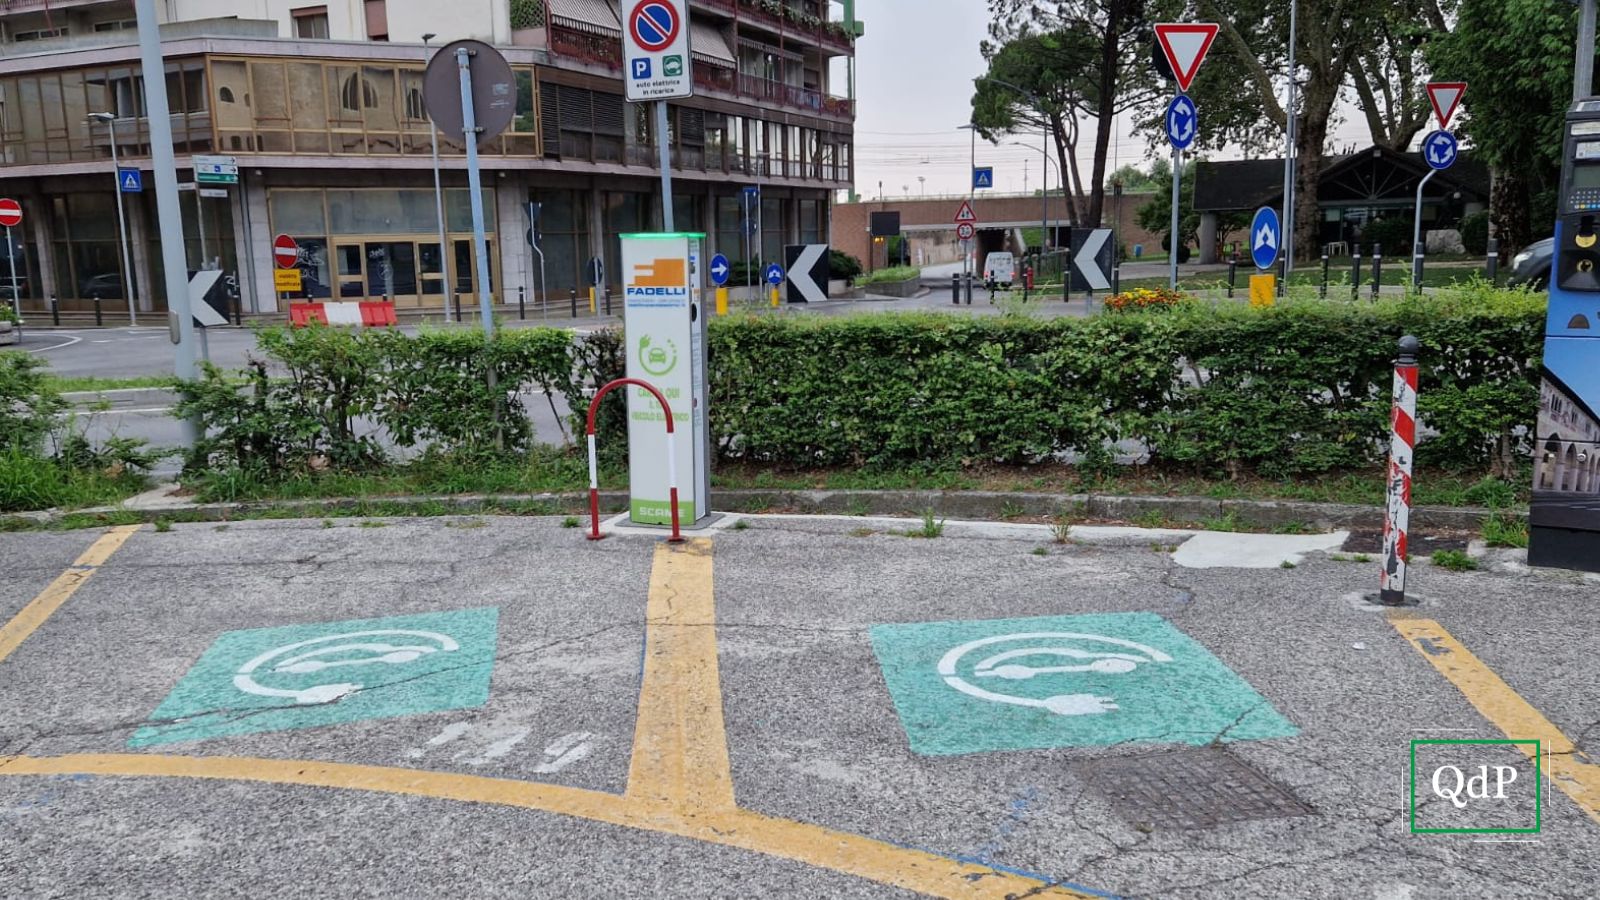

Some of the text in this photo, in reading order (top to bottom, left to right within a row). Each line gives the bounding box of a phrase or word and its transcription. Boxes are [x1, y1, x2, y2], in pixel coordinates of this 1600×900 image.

[636, 61, 647, 77] P
[652, 79, 681, 87] elettrica
[627, 287, 686, 296] FADELLI
